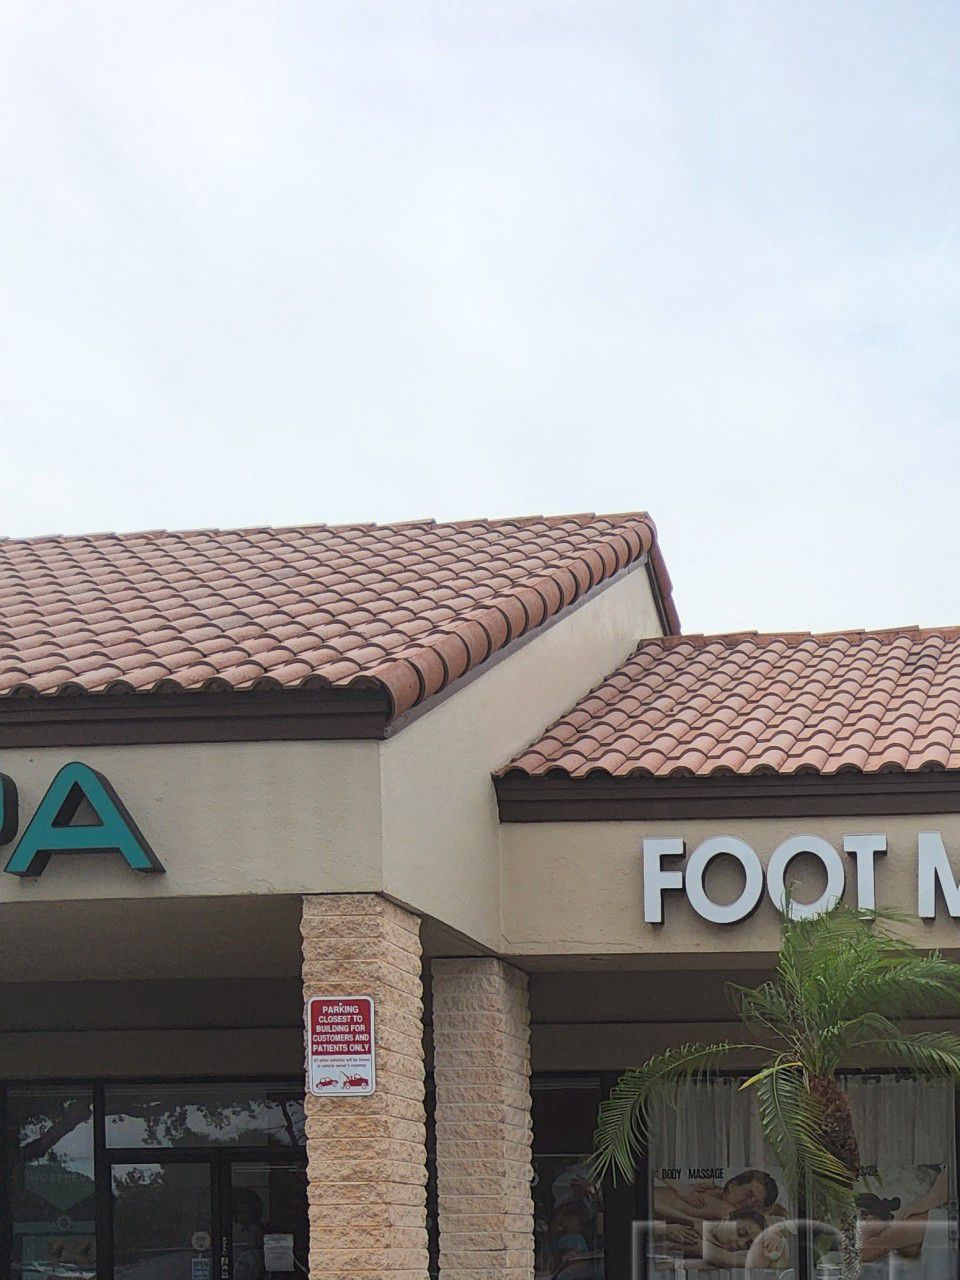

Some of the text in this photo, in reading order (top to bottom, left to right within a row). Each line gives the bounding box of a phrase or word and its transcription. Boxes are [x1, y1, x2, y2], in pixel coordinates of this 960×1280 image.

[643, 832, 888, 923] FOOT
[322, 1005, 359, 1014] PARKING
[318, 1015, 363, 1023] CLOSEST TO
[316, 1025, 349, 1033] BUILDING
[312, 1034, 370, 1042] CUSTOMERS AND
[312, 1044, 370, 1053] PATIENTS ONLY
[661, 1167, 724, 1180] BODY MASSAGE
